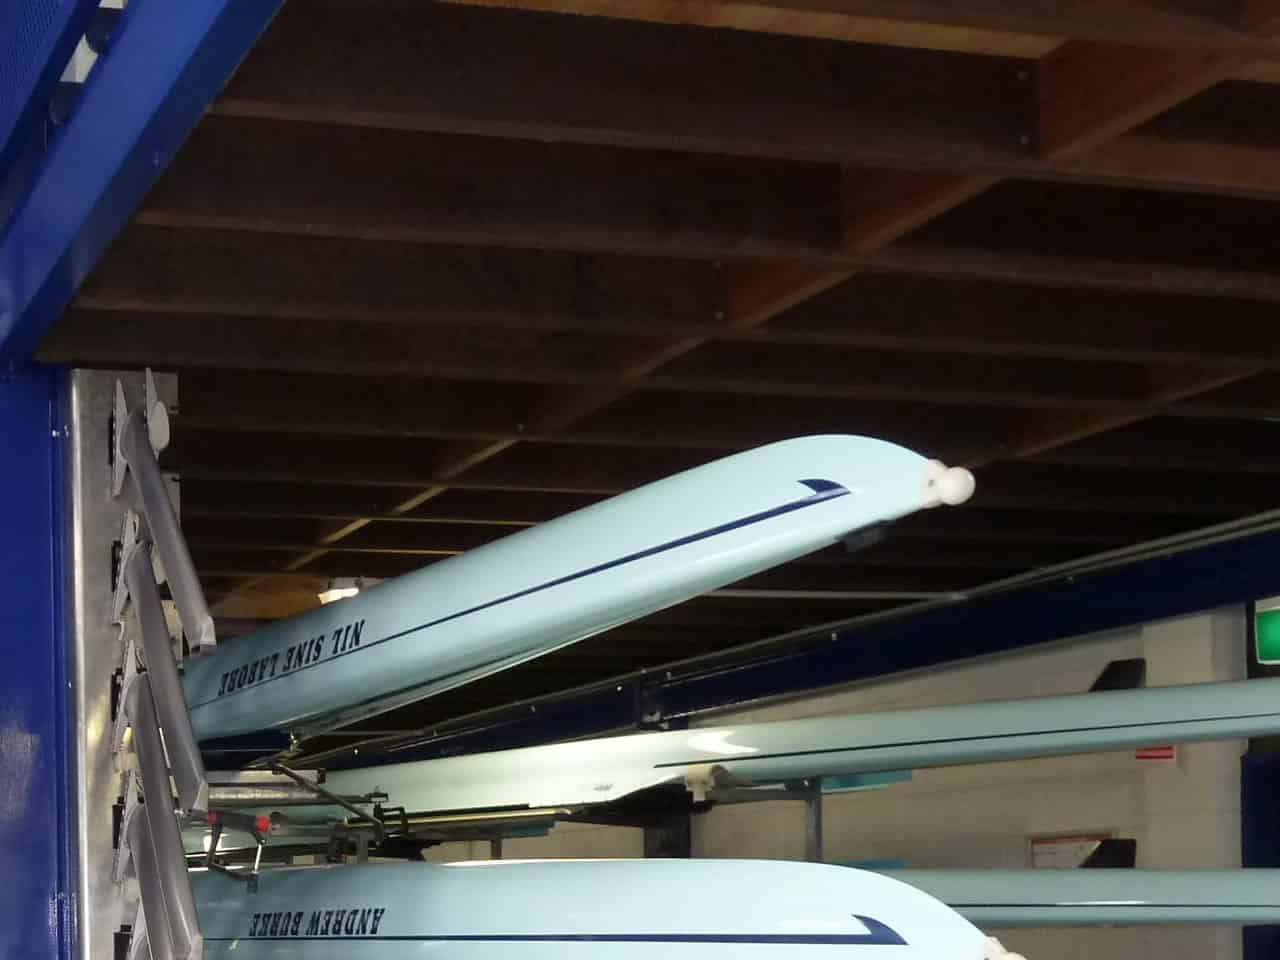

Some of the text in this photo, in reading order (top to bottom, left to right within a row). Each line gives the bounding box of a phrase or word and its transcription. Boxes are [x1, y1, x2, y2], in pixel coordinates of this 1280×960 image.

[218, 619, 365, 696] NIL SINE LABORE
[249, 908, 385, 937] ANDREW BURKE
